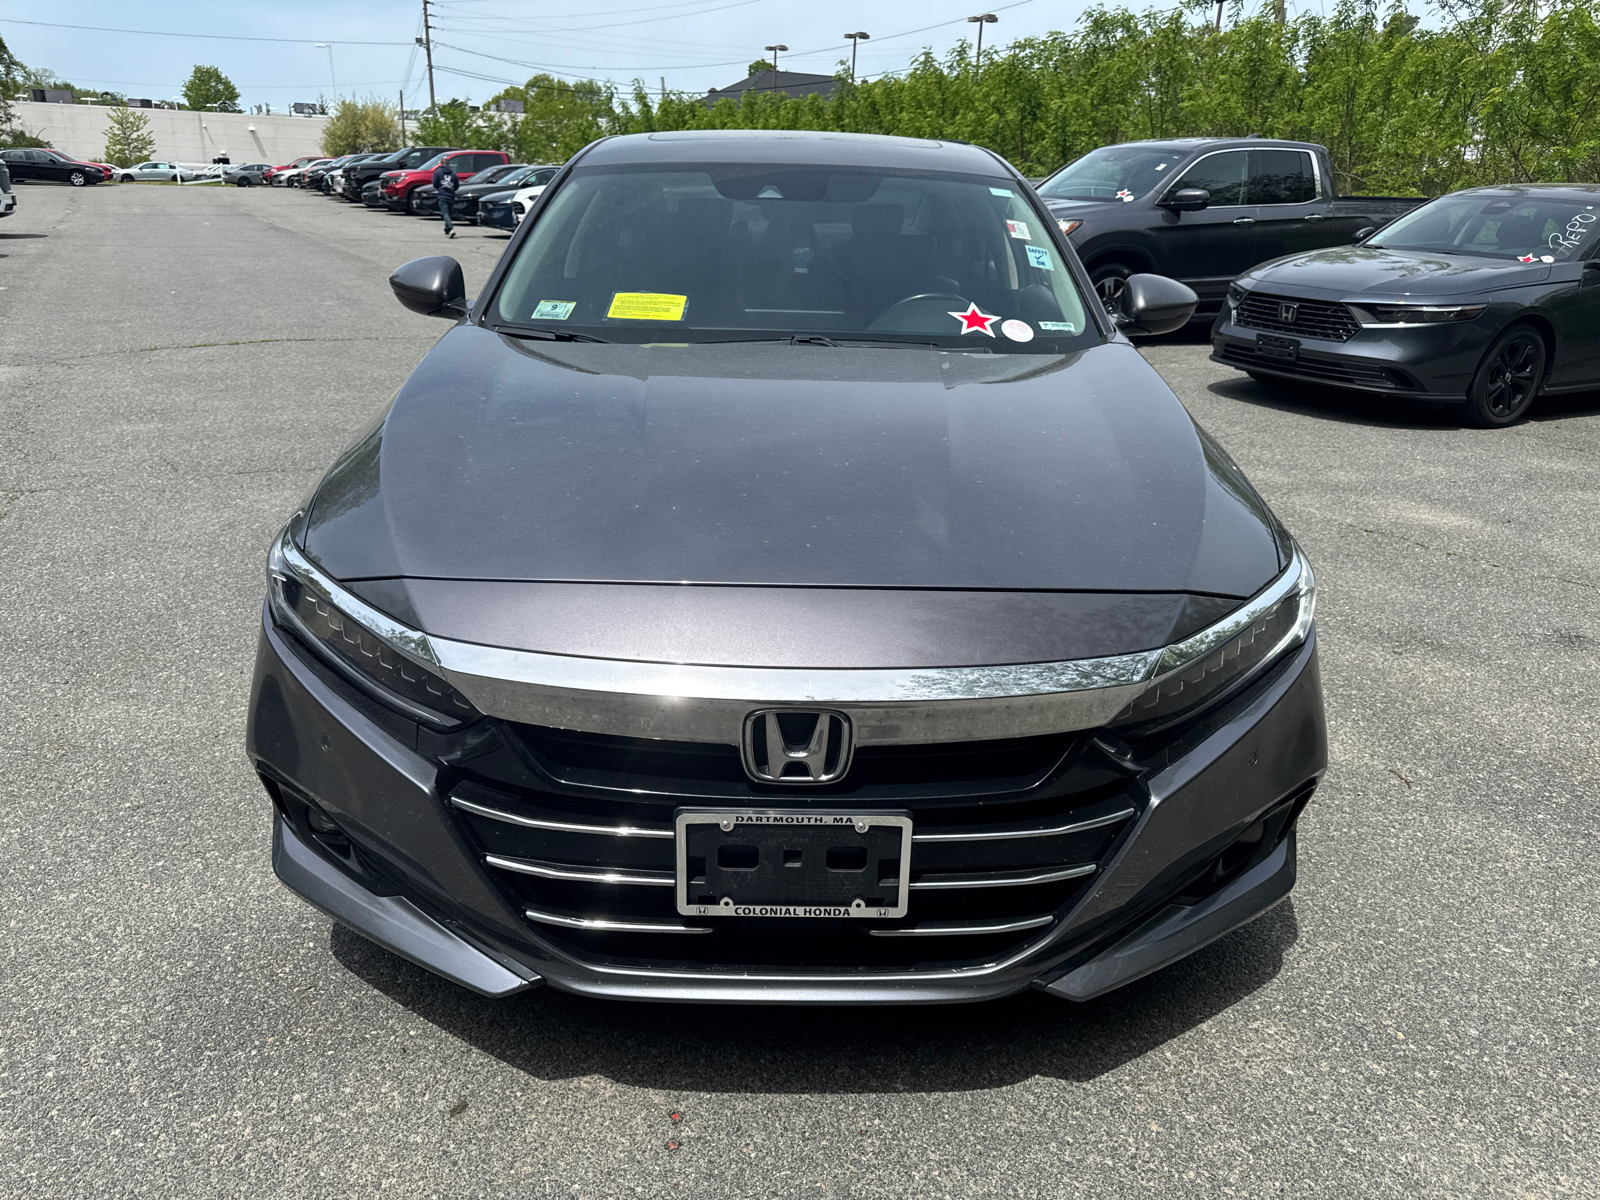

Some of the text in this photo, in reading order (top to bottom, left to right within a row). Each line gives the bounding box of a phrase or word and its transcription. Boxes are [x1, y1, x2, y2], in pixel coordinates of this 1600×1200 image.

[1549, 213, 1596, 248] REPO
[734, 907, 851, 917] COLONIAL HONDA
